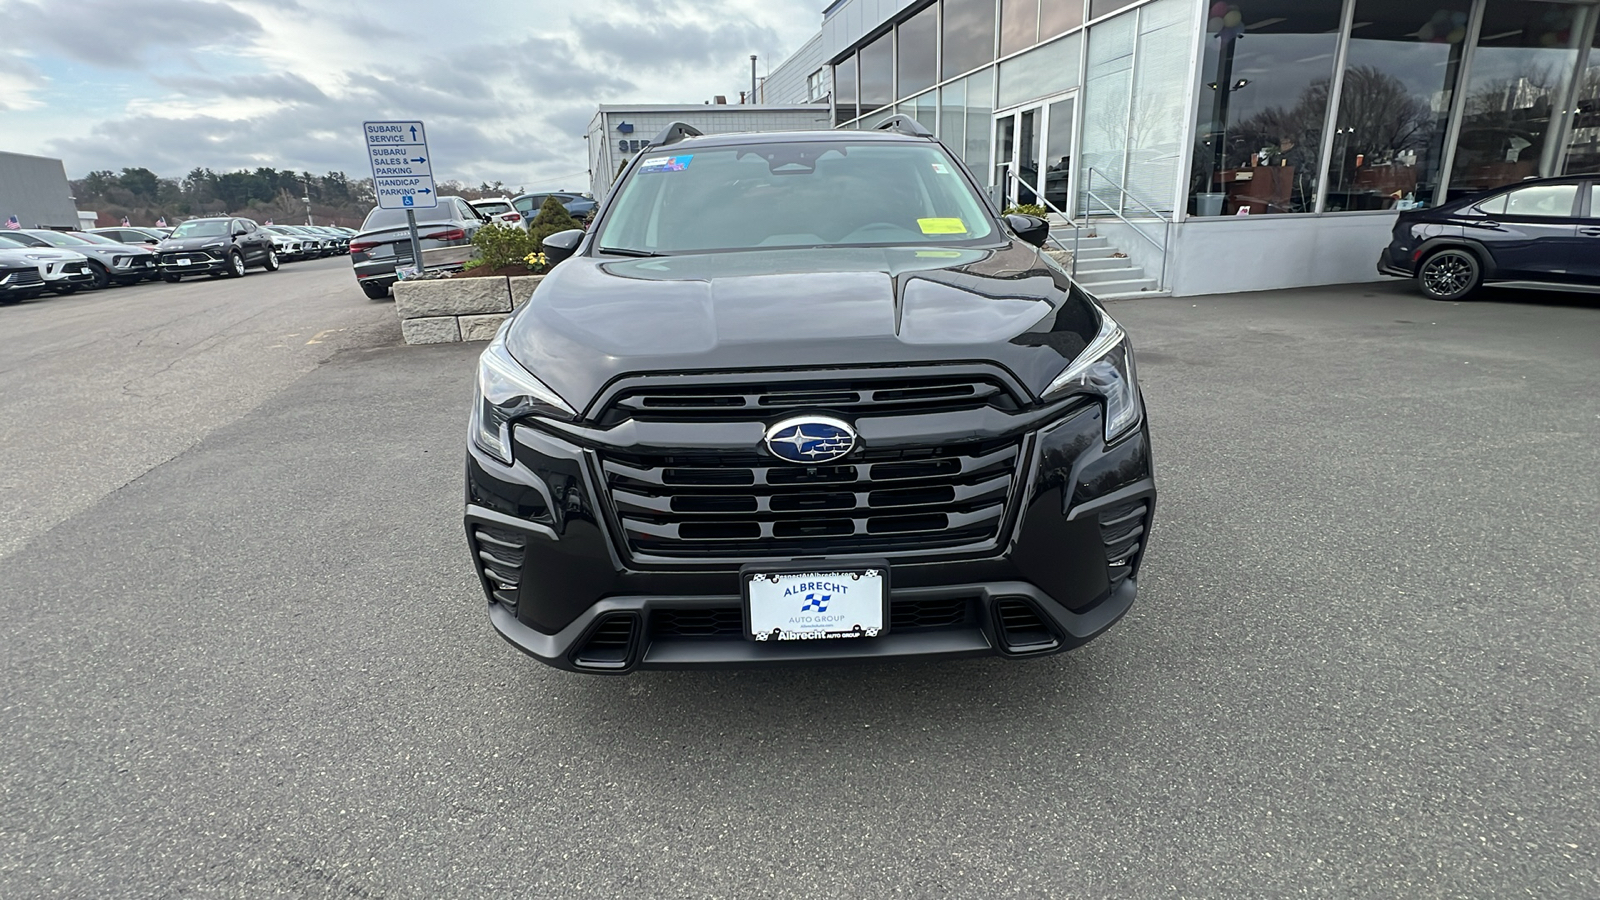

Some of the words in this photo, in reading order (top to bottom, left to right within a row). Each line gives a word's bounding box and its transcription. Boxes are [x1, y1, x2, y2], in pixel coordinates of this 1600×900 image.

[367, 125, 402, 133] SUBARU
[370, 135, 405, 143] SERVICE
[372, 148, 406, 156] SUBARU
[374, 158, 401, 166] SALES
[376, 167, 412, 175] PARKING
[378, 178, 420, 187] HANDICAP
[380, 188, 416, 196] PARKING
[784, 582, 848, 597] ALBRECHT
[789, 616, 813, 624] AUTO
[814, 614, 845, 623] GROUP
[778, 630, 826, 640] Albrecht
